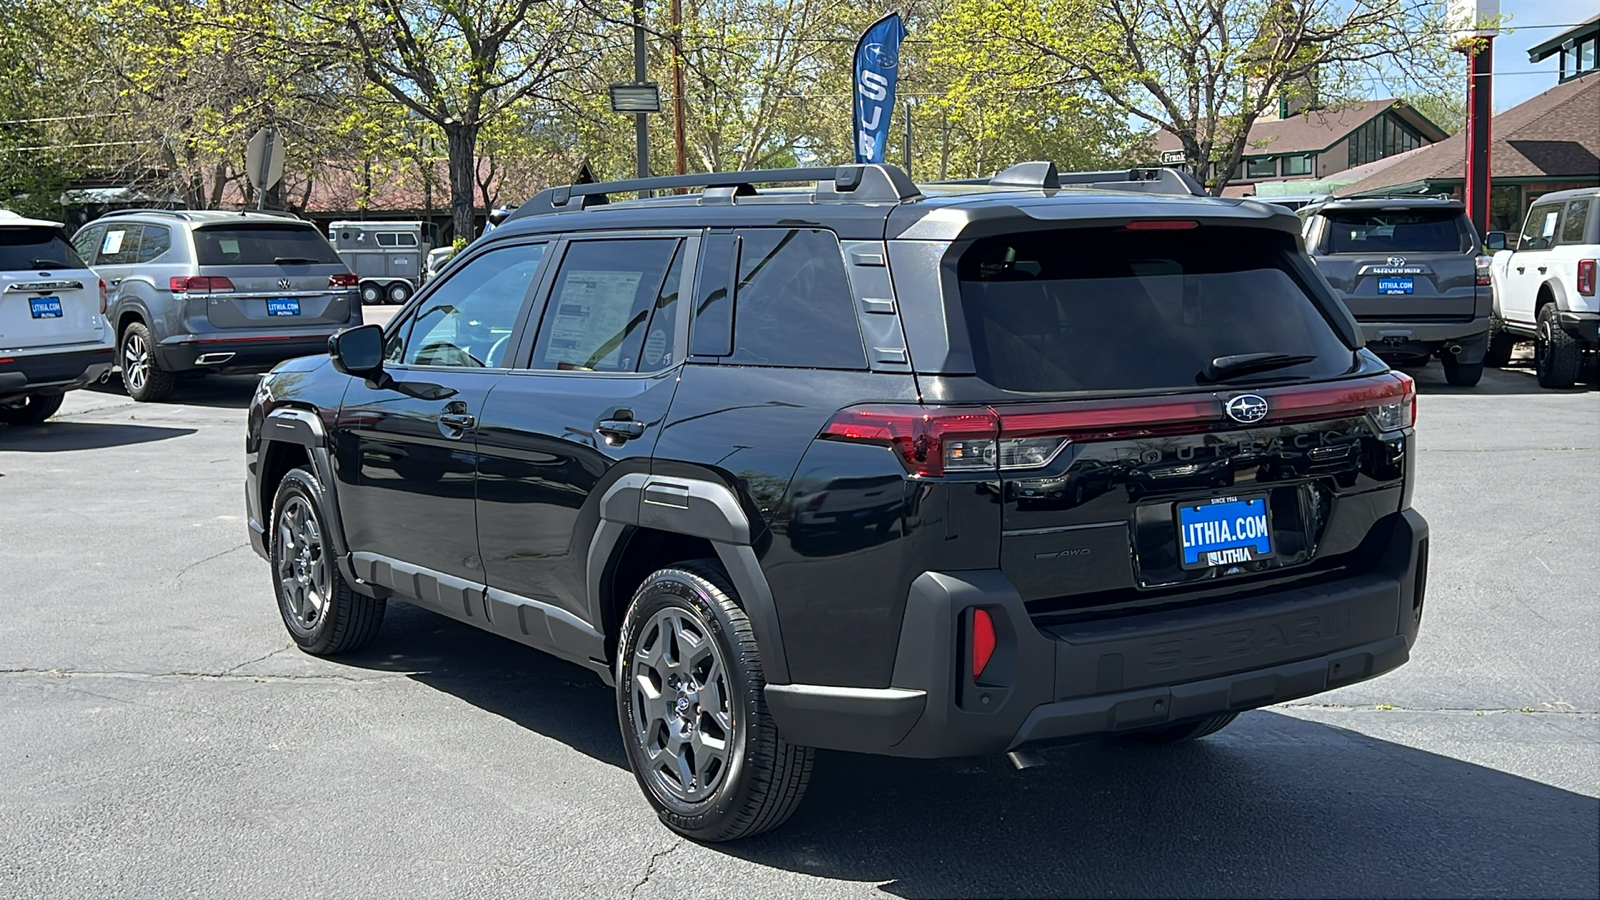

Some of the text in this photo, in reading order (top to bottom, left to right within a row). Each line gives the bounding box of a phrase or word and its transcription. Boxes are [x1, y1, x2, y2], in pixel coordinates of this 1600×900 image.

[858, 69, 888, 160] SUB
[31, 302, 60, 312] LITHIA.COM
[268, 302, 299, 311] LITHIA.COM
[1139, 431, 1343, 464] OUTBACK
[1182, 514, 1268, 547] LITHIA.COM
[1059, 548, 1091, 556] AWD
[1217, 547, 1252, 565] LITHIA
[1145, 609, 1350, 672] SUBARU
